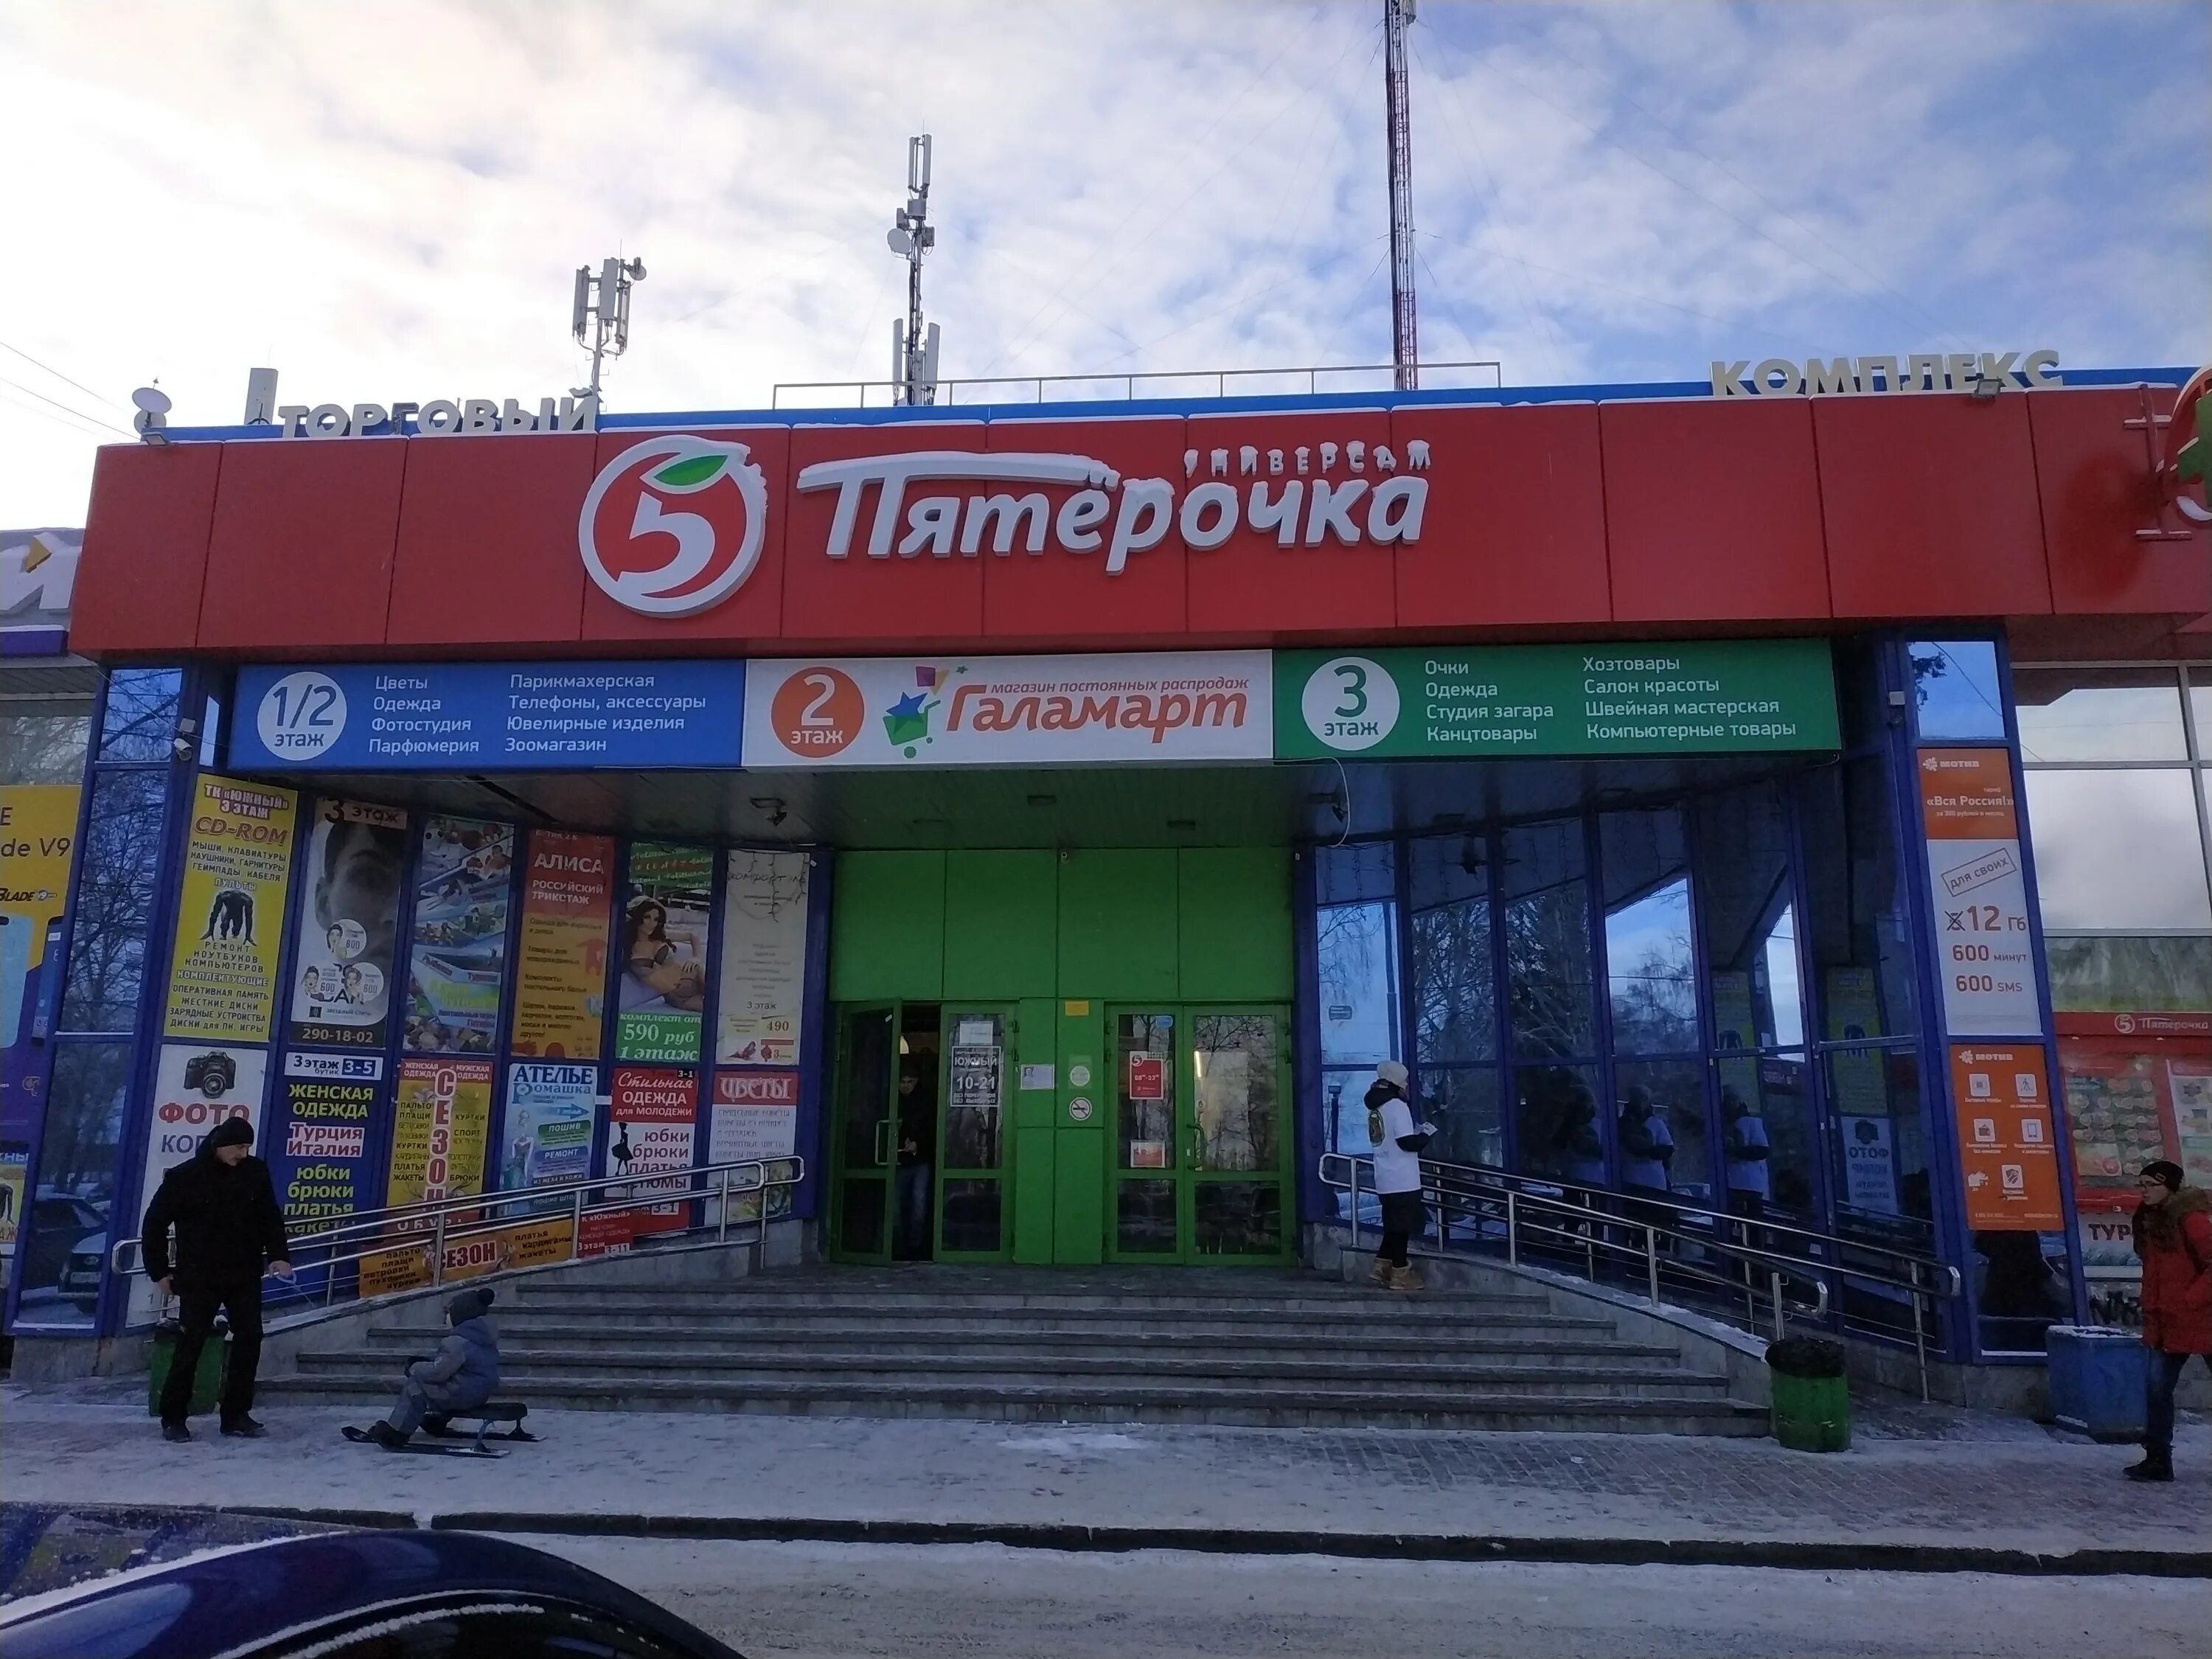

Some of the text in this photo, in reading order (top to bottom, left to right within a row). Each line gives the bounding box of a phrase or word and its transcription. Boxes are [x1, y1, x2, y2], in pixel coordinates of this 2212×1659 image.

[1711, 350, 2062, 396] КОМПЛЕКС
[279, 386, 597, 439] ТОРГОВЫЙ
[1425, 659, 1469, 675] Очки
[1582, 656, 1680, 673] Хозтовары
[375, 675, 428, 692] Цветы
[510, 674, 655, 692] Парикмахерская
[991, 676, 1250, 694] магазин постоянных распродаж
[1333, 664, 1368, 718] 3
[1425, 681, 1498, 699] Одежда
[1584, 678, 1719, 696] Салон красоты
[272, 684, 338, 728] 1/2
[373, 697, 441, 712] Одежда
[509, 695, 706, 712] Телефоны, аксессуары
[801, 673, 835, 726] 2
[946, 684, 1248, 744] Галамарт
[1426, 703, 1554, 723] Студия загара
[1585, 700, 1780, 717] Швейная мастерская
[372, 717, 471, 734] Фотостудия
[507, 716, 684, 733] Ювелирные изделия
[1324, 721, 1380, 737] этаж
[1586, 722, 1797, 740] Компьютерные товары
[274, 733, 324, 747] этаж
[790, 728, 844, 745] этаж
[1427, 726, 1537, 743] Канцтовары
[369, 738, 479, 756] Парфюмерия
[504, 737, 607, 752] Зоомагазин
[205, 785, 221, 798] ТК
[1927, 795, 1956, 806] «Вся
[233, 804, 269, 818] ЭТАЖ
[352, 804, 399, 823] этаж
[195, 816, 288, 846] CD-ROM
[39, 837, 71, 857] V9
[227, 846, 286, 861] КЛАВИАТУРЫ
[239, 858, 285, 872] ГАРНИТУРЫ
[534, 852, 605, 875] АЛИСА
[247, 871, 281, 882] КАБЕЛЯ
[1950, 858, 2010, 890] ДЛЯ СВОИХ
[214, 877, 257, 891] ПУЛЬТЫ
[532, 879, 604, 895] РОССИЙСКИЙ
[1966, 905, 2027, 931] 12 Гб
[205, 941, 251, 953] РЕМОНТ
[1952, 945, 2028, 963] 600 минут
[193, 950, 258, 964] НОУТБУКОВ
[184, 959, 264, 973] КОМПЬЮТЕРОВ
[176, 970, 269, 987] КОМПЛЕКТУЮЩИЕ
[1955, 975, 2023, 992] 600 SMS
[173, 984, 269, 1001] ОПЕРАТИВНАЯ ПАМЯТЬ
[181, 997, 258, 1011] ЖЕСТКИЕ ДИСКИ
[170, 1007, 214, 1018] ЗАРЯДНЫЕ
[619, 1013, 701, 1023] комплект от
[170, 1018, 264, 1033] ДИСКИ для ИГРЫ
[767, 1020, 790, 1032] 490
[302, 1027, 374, 1043] 290-18-02
[624, 1023, 695, 1046] 590 руб
[619, 1046, 698, 1061] 1 этаж
[954, 1056, 998, 1066] ЮЖНЫЙ
[293, 1055, 373, 1075] 3 этаж 3-5
[314, 1067, 339, 1076] бутик
[405, 1062, 439, 1070] ЖЕНСКАЯ
[456, 1064, 490, 1073] МУЖСКАЯ
[403, 1069, 437, 1078] ОДЕЖДА
[457, 1072, 489, 1081] ОДЕЖДА
[513, 1065, 594, 1085] АТЕЛЬЕ
[618, 1071, 694, 1089] Стильная
[678, 1069, 694, 1078] 3-1
[720, 1077, 792, 1102] ЦВЕТЫ
[956, 1076, 995, 1090] 10-21
[288, 1083, 374, 1101] ЖЕНСКАЯ
[512, 1082, 591, 1105] Ромашка
[622, 1091, 686, 1105] ОДЕЖДА
[293, 1101, 369, 1119] ОДЕЖДА
[400, 1102, 432, 1110] ПАЛЬТО
[616, 1107, 692, 1117] для МОЛОДЕЖИ
[399, 1112, 431, 1120] ПЛАЩИ
[292, 1123, 363, 1143] Турция
[548, 1121, 581, 1133] ПОШИВ
[644, 1128, 689, 1144] юбки
[288, 1140, 361, 1157] Италия
[544, 1148, 579, 1159] РЕМОНТ
[633, 1144, 689, 1161] брюки
[296, 1163, 350, 1180] юбки
[288, 1180, 355, 1202] брюки
[283, 1203, 354, 1217] платья
[515, 1230, 549, 1241] платья
[386, 1248, 421, 1259] пальто
[518, 1248, 557, 1260] жакеты
[584, 1241, 605, 1251] этаж
[381, 1256, 414, 1268] плащи
